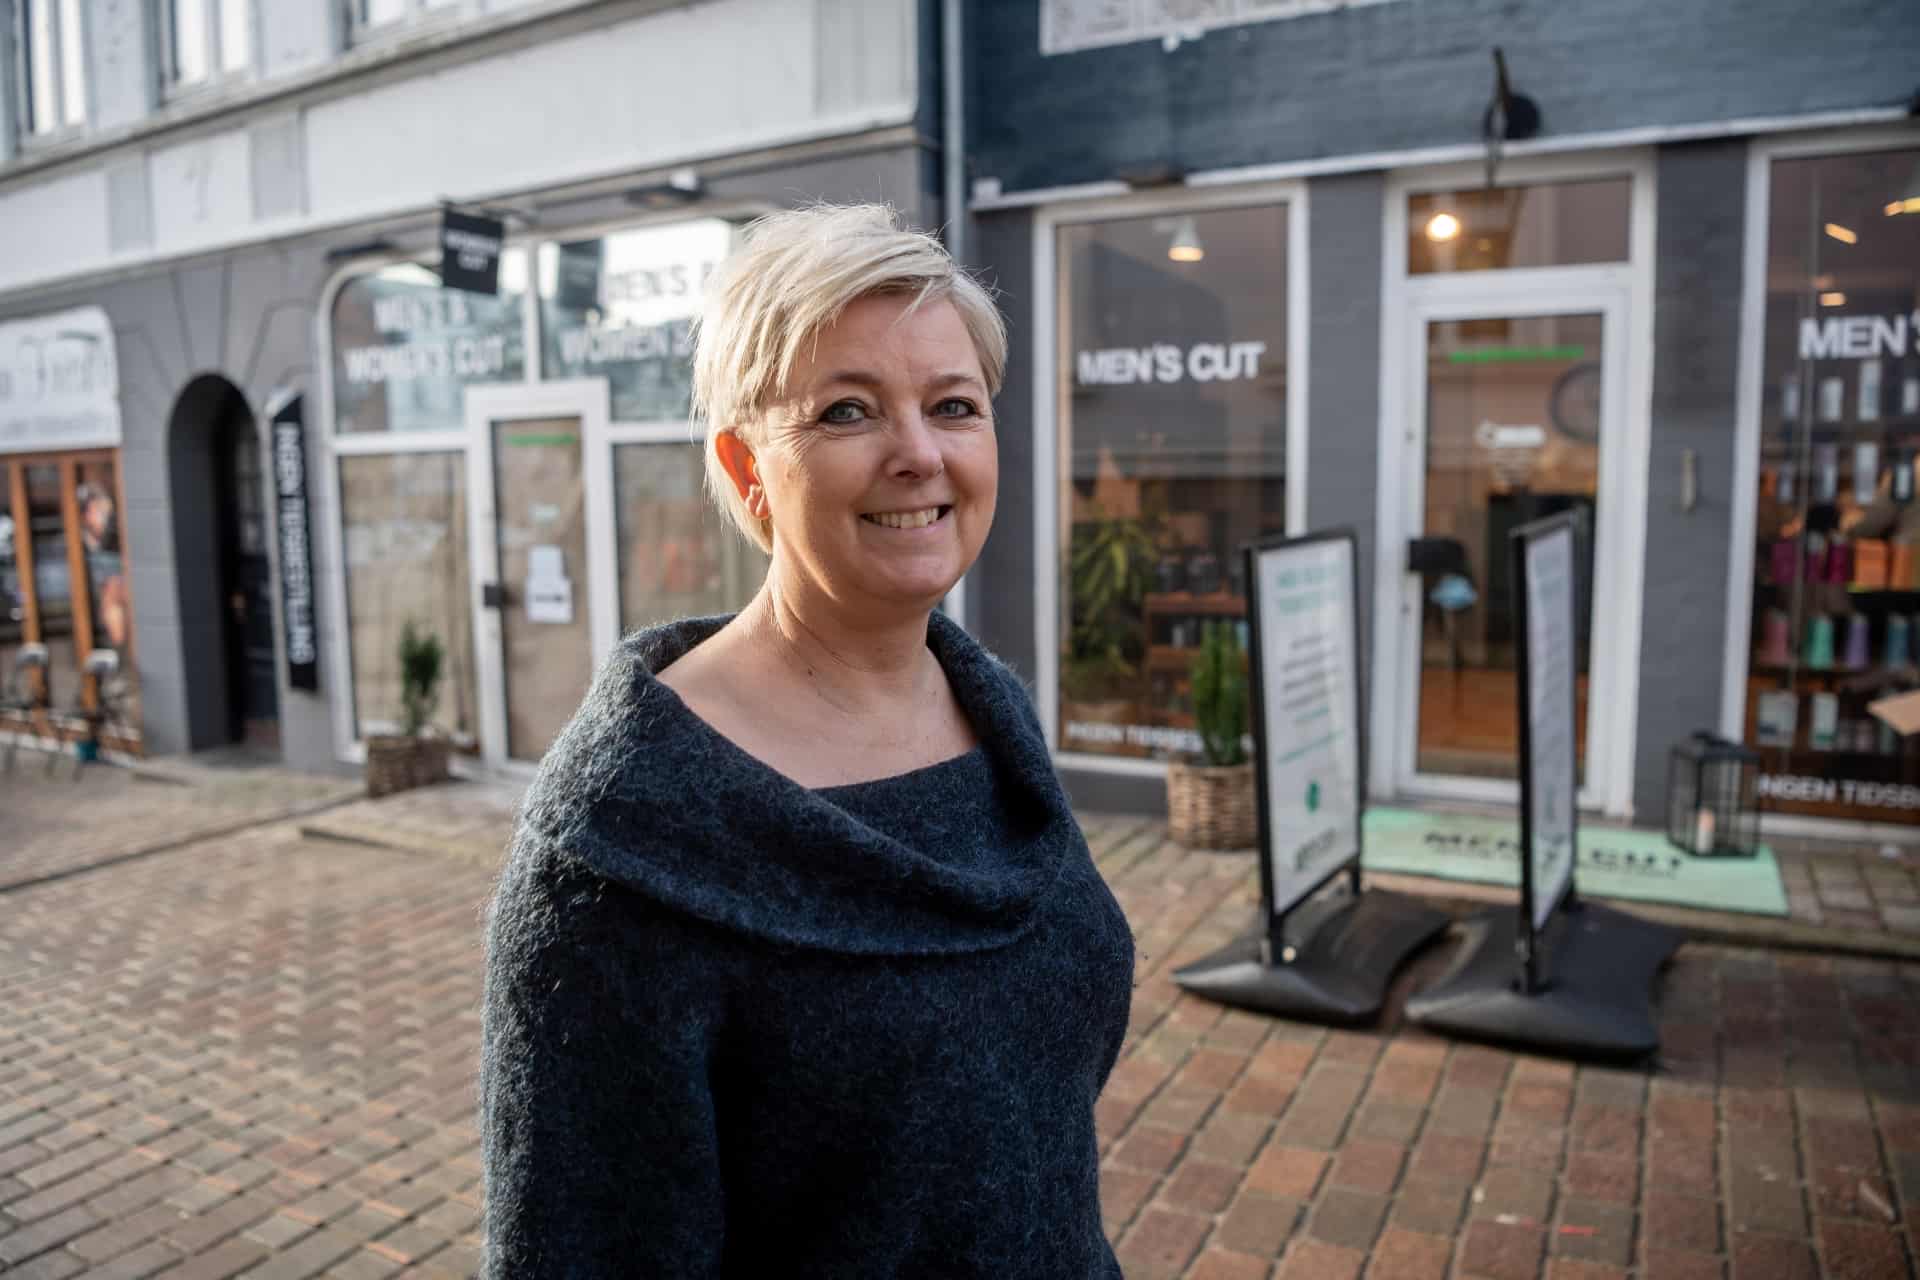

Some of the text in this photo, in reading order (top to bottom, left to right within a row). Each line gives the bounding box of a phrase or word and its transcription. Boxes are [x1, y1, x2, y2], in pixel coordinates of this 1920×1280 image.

[1078, 341, 1265, 385] MEN'S CUT
[1758, 773, 1837, 803] NGEN
